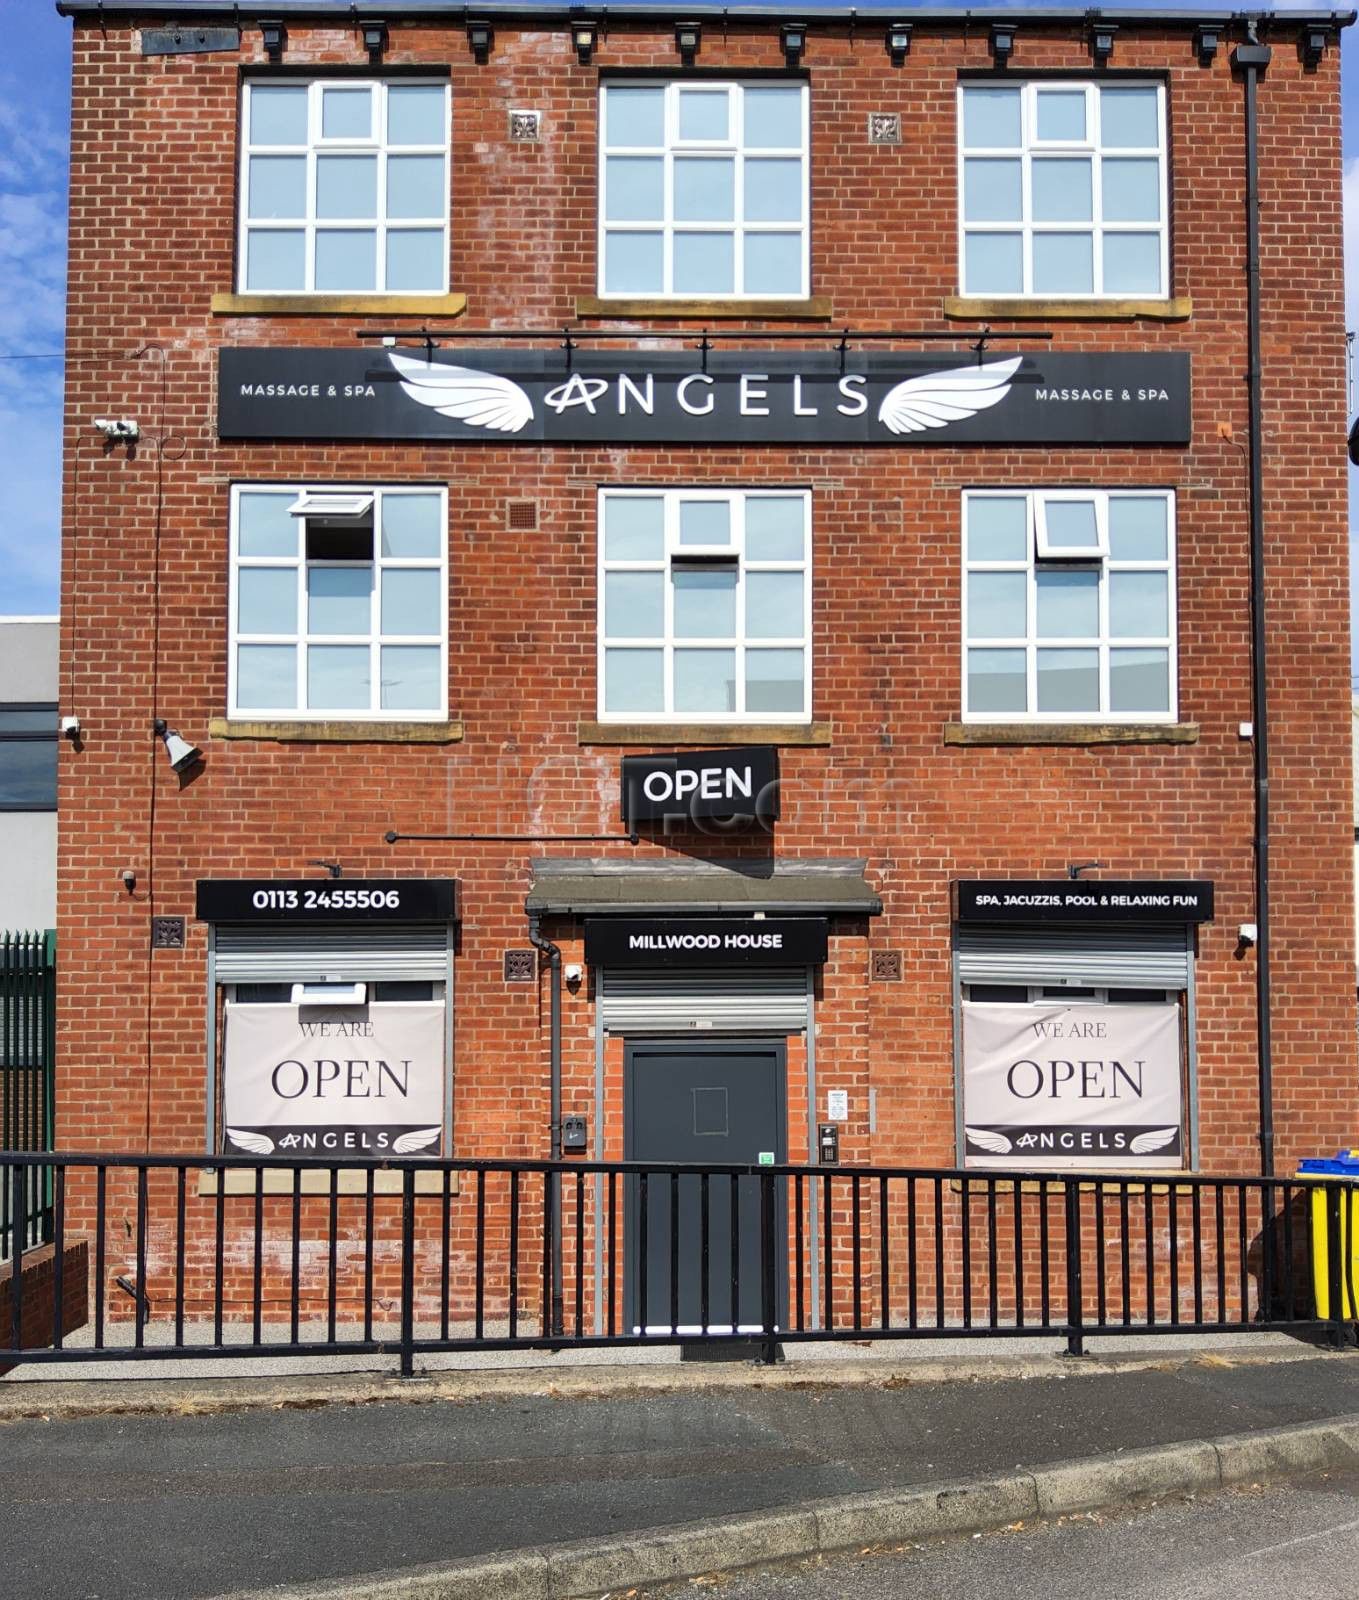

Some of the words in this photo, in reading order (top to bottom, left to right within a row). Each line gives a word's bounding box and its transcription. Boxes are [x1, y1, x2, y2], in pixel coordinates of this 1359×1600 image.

[240, 384, 320, 397] MASSAGE
[327, 384, 337, 397] &
[344, 384, 376, 397] SPA
[543, 373, 869, 416] ANGELS
[1035, 388, 1114, 401] MASSAGE
[1121, 388, 1131, 401] &
[1137, 388, 1169, 401] SPA
[643, 766, 752, 802] OPEN
[252, 890, 299, 909] 0113
[304, 890, 400, 909] 2455506
[1065, 895, 1098, 906] POOL
[1100, 895, 1109, 906] &
[1110, 895, 1171, 906] RELAXING
[1172, 895, 1198, 906] FUN
[629, 934, 721, 949] MILLWOOD
[724, 934, 783, 949] HOUSE
[299, 1022, 331, 1037] WE
[336, 1021, 374, 1037] ARE
[1032, 1022, 1066, 1039] WE
[1068, 1022, 1107, 1039] ARE
[271, 1060, 411, 1099] OPEN
[1006, 1060, 1145, 1099] OPEN
[278, 1132, 389, 1149] ANGELS
[1015, 1132, 1126, 1149] ANGELS
